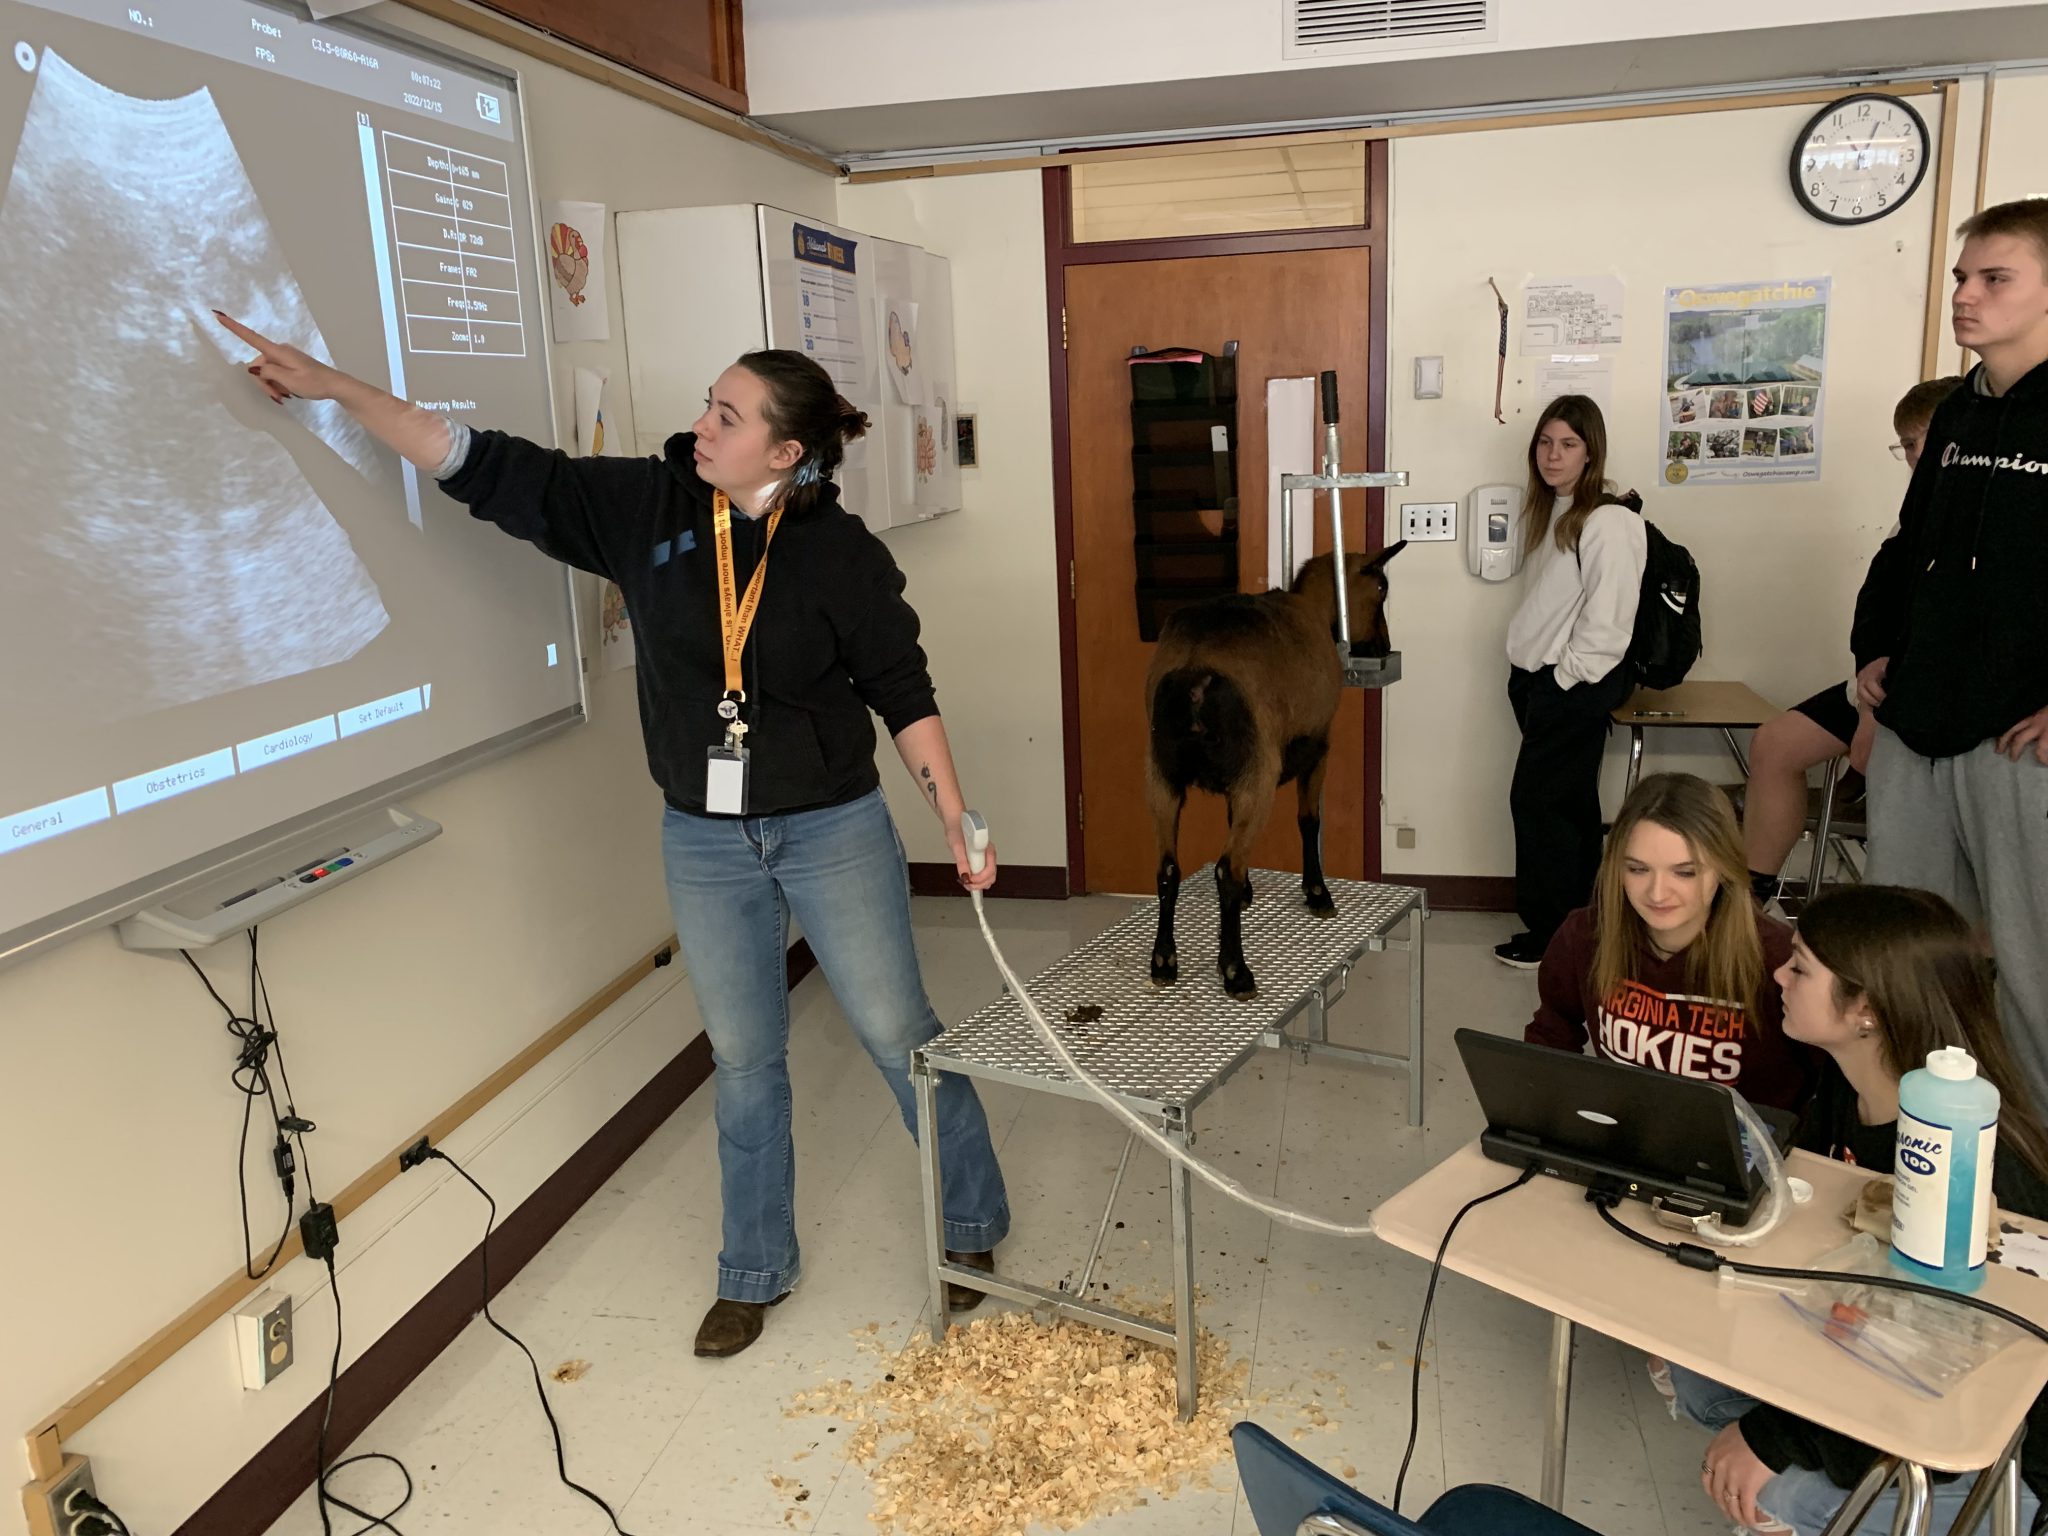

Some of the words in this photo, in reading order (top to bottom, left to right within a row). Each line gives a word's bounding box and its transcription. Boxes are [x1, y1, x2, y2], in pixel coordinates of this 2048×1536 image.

[251, 18, 282, 38] Probe:
[255, 46, 276, 63] FPS:
[1857, 104, 1871, 117] 12
[1832, 113, 1842, 127] 11
[1903, 123, 1912, 136] 2
[427, 156, 450, 171] Depth:
[1906, 149, 1915, 162] 3
[1806, 158, 1816, 173] 9
[1895, 172, 1906, 186] 4
[1810, 182, 1820, 197] 8
[1829, 199, 1838, 212] 7
[1851, 202, 1862, 215] 6
[1877, 194, 1887, 207] 5
[439, 262, 461, 274] Frame:
[451, 331, 469, 342] Zoom:
[717, 499, 725, 517] than
[720, 519, 728, 560] important
[724, 587, 733, 617] always
[741, 604, 753, 624] than
[358, 711, 373, 724] Set
[375, 701, 404, 719] Default
[264, 732, 313, 756] Cardiology
[146, 766, 206, 794] Obstetrics
[11, 811, 63, 838] General
[1604, 987, 1680, 1030] IRGINIA
[1688, 1003, 1745, 1039] TECH
[1598, 1005, 1743, 1081] HOKIES
[1903, 1151, 1931, 1172] 100
